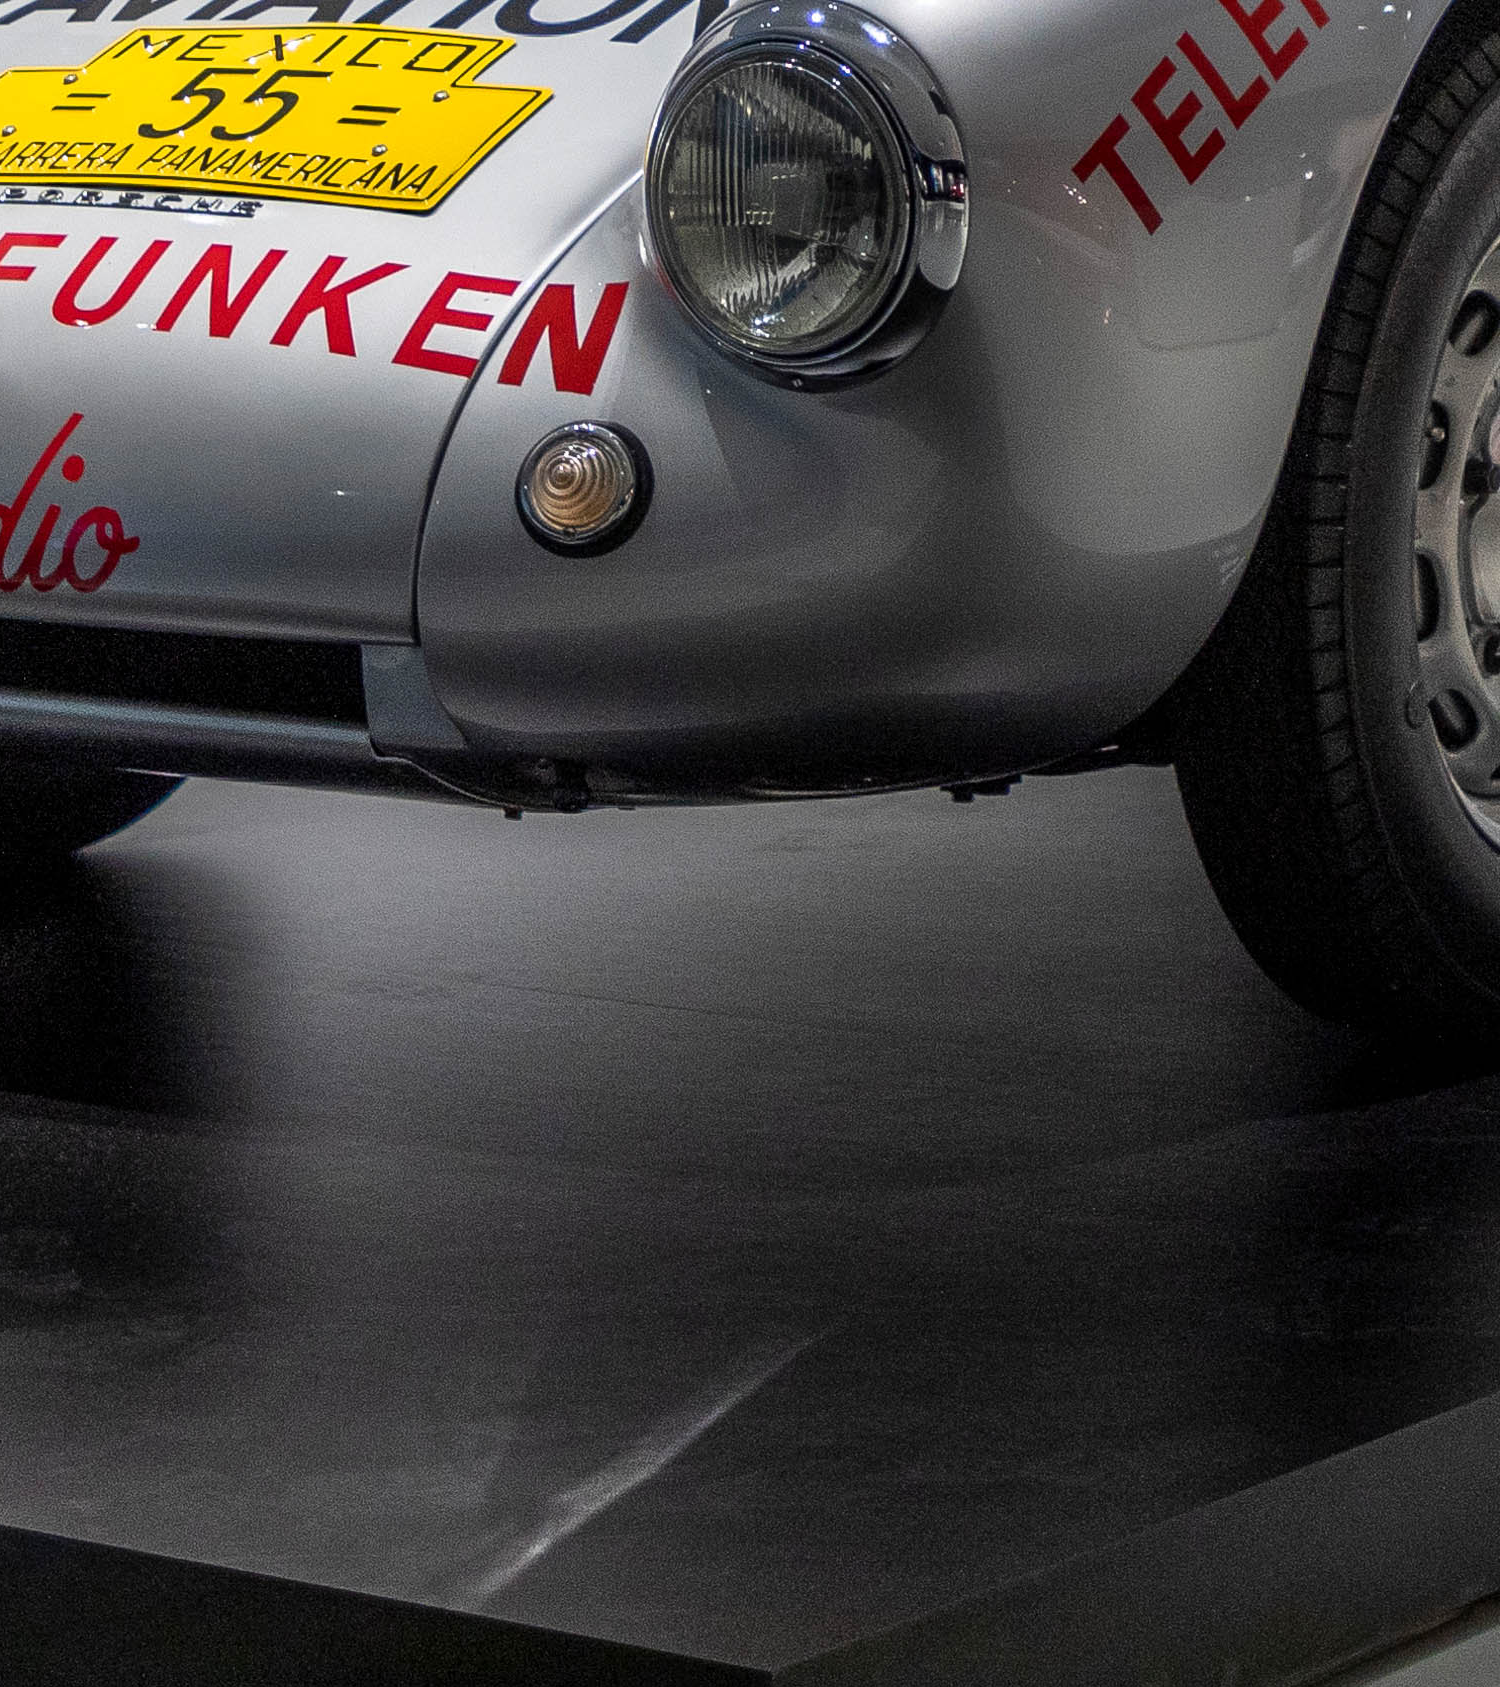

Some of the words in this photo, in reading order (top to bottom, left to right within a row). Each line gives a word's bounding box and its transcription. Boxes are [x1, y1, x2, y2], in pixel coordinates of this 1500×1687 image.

[113, 33, 479, 73] MEXICO
[137, 67, 336, 141] 55
[138, 142, 439, 196] PANAMERICANA
